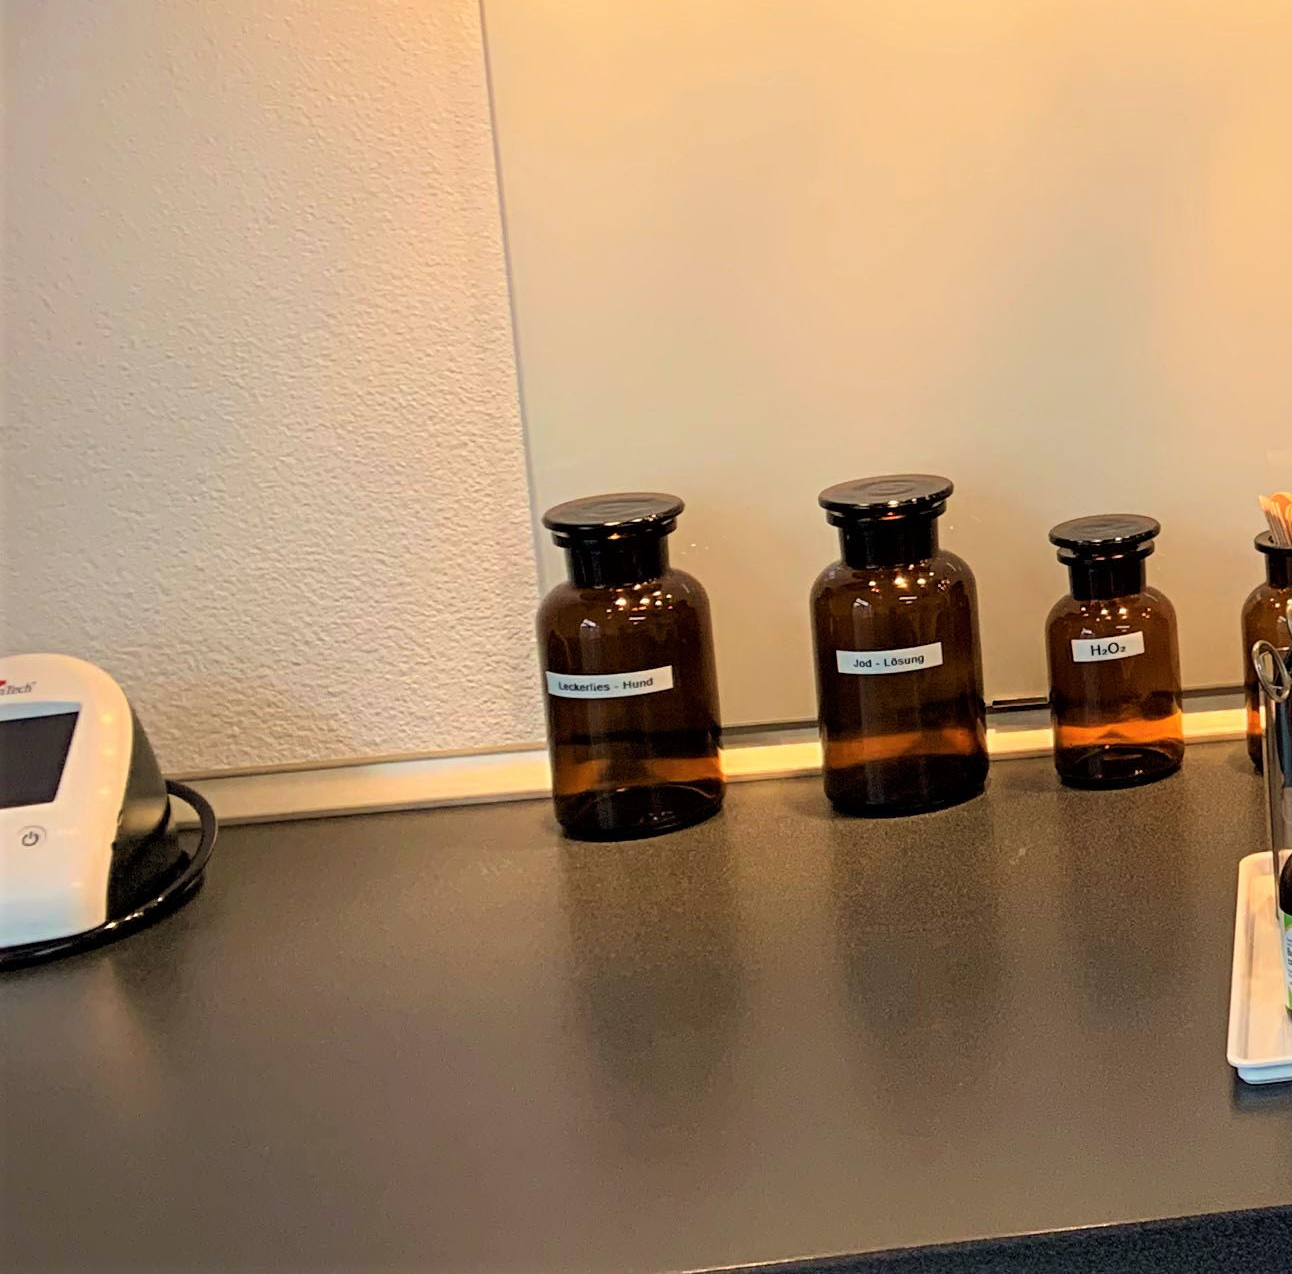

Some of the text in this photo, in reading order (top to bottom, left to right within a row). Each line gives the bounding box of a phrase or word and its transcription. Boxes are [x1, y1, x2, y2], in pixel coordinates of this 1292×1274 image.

[853, 659, 872, 668] Jod
[884, 655, 925, 667] Lösung
[558, 681, 610, 692] Leckerlies
[623, 678, 654, 689] Hund
